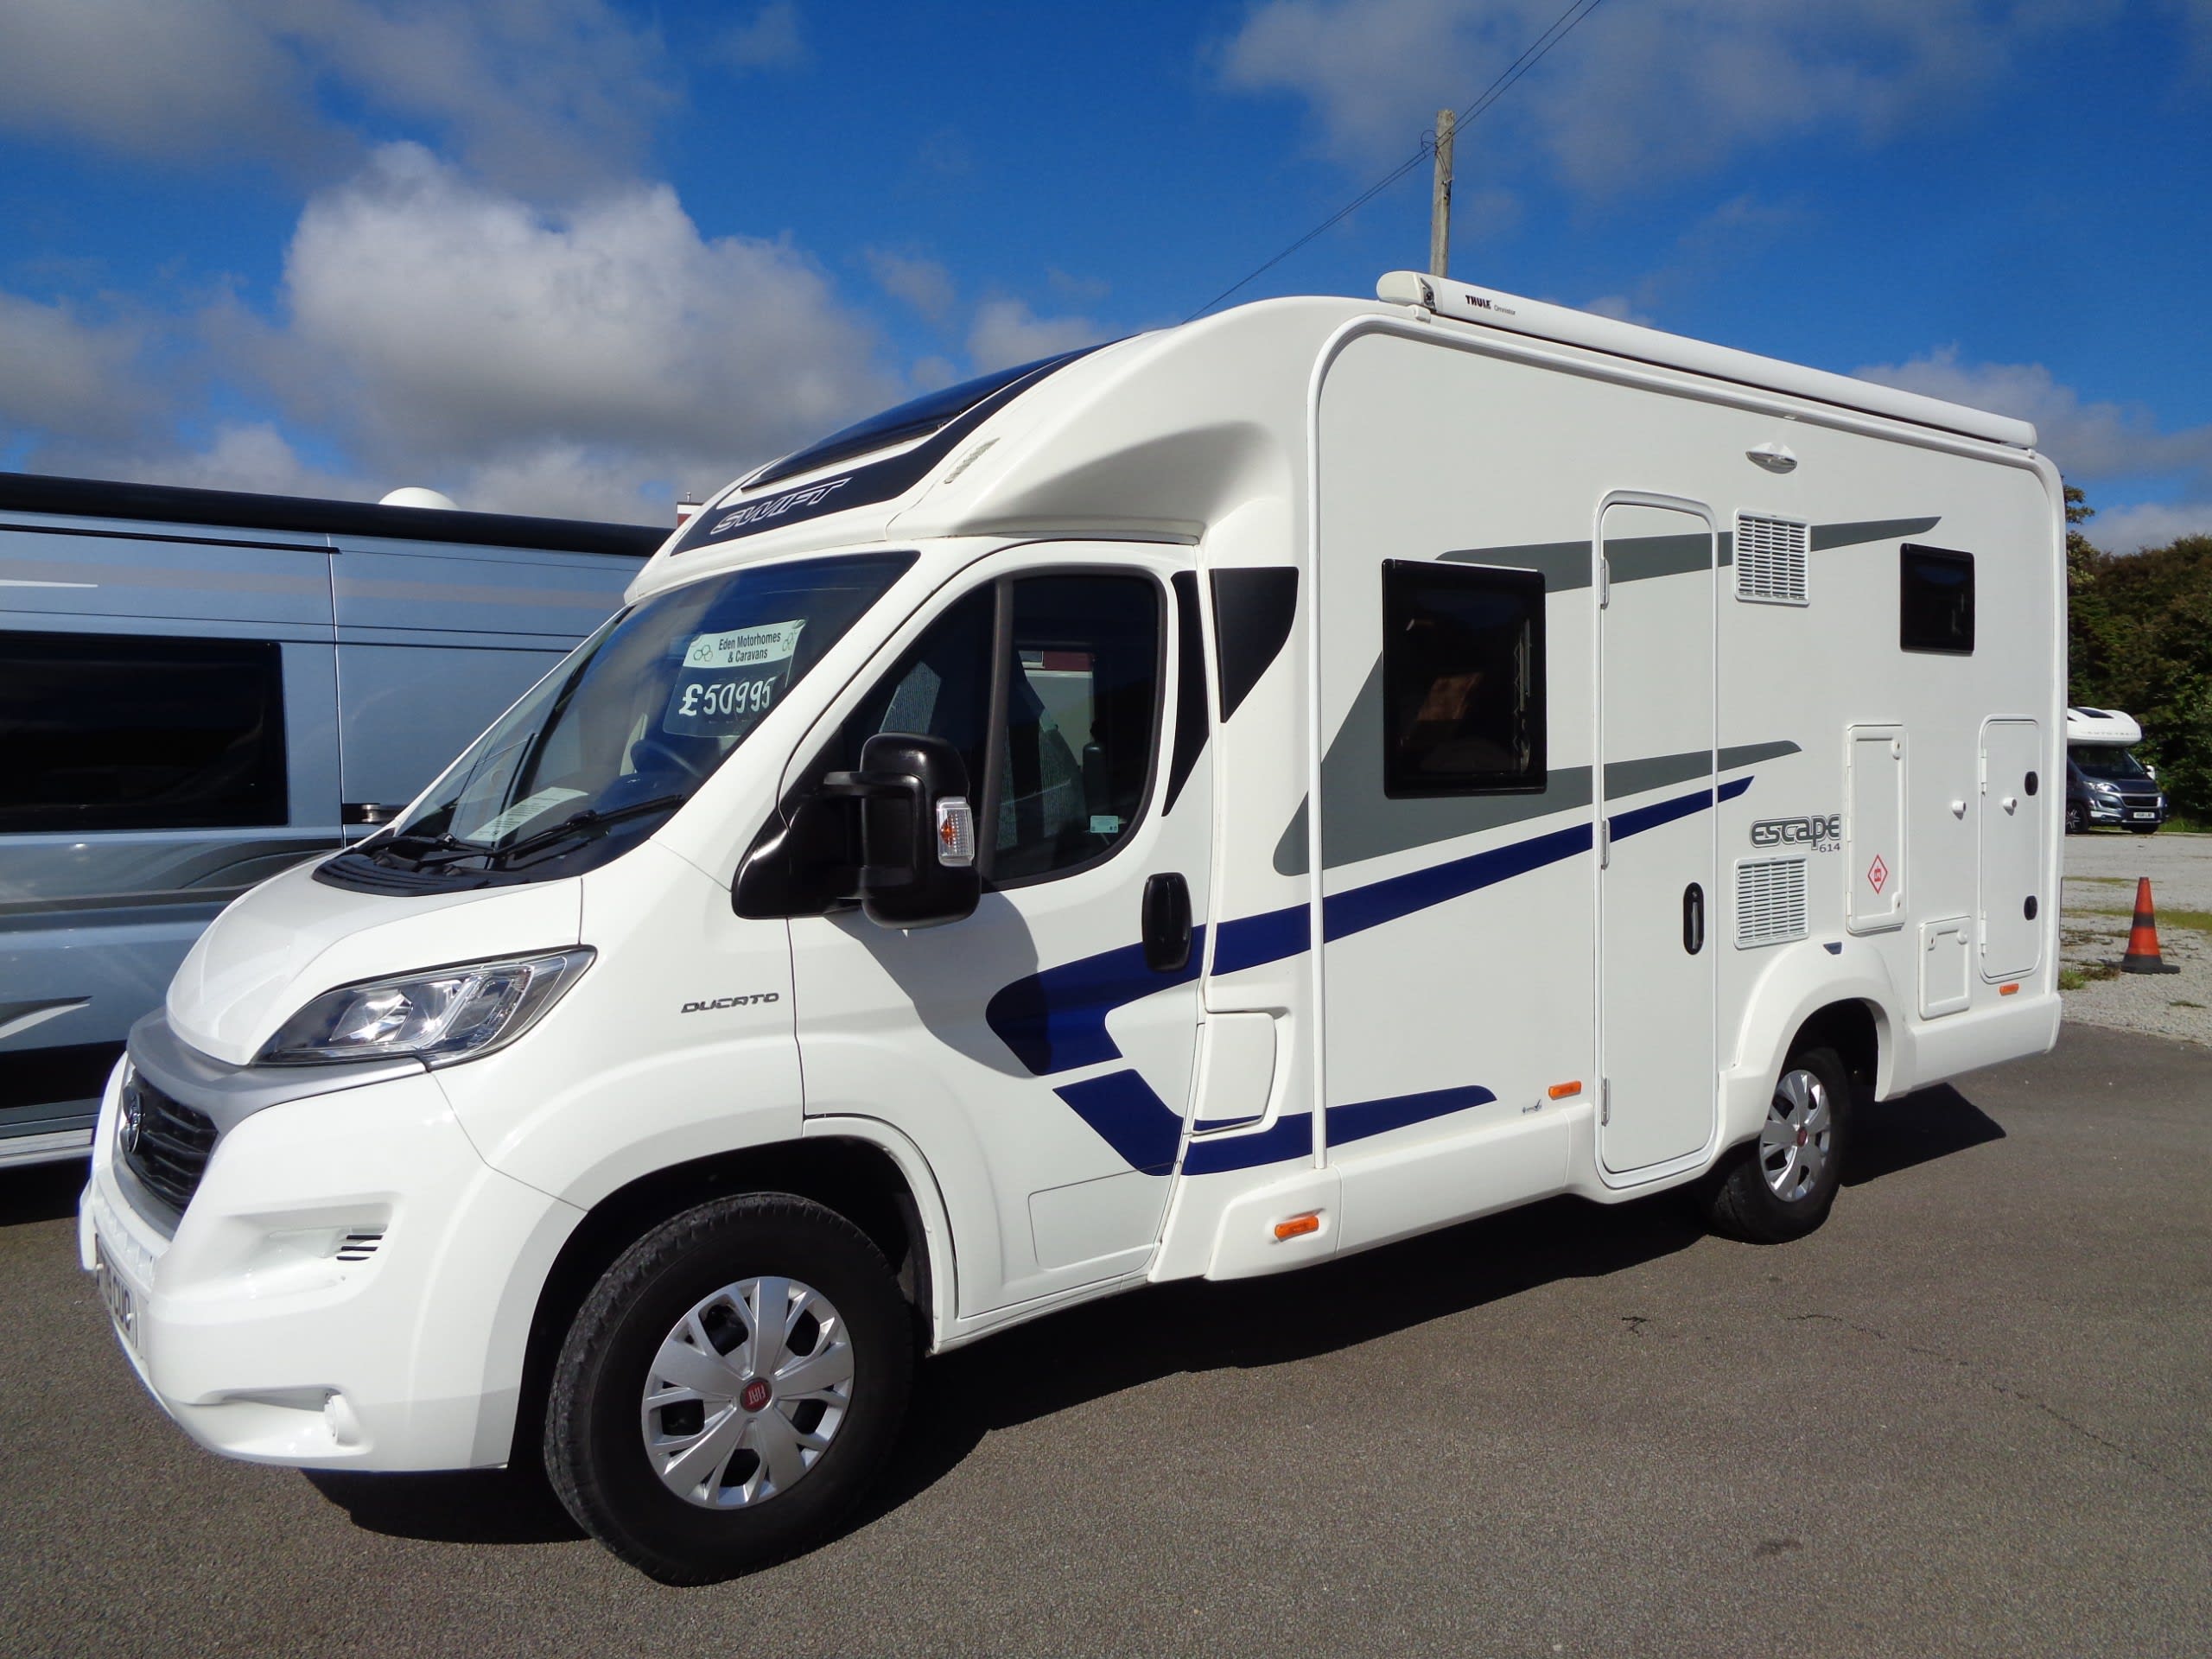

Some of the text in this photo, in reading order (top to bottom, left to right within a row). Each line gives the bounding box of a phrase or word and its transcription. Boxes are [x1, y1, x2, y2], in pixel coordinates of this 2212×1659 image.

[1465, 295, 1492, 309] THULE
[710, 477, 853, 535] SWIFT
[719, 632, 781, 651] Eden Motorhomes
[728, 649, 768, 663] & Caravans
[678, 676, 778, 716] £50995
[1819, 842, 1840, 853] 614
[681, 993, 779, 1014] DUCATO
[747, 1384, 766, 1405] FIAT
